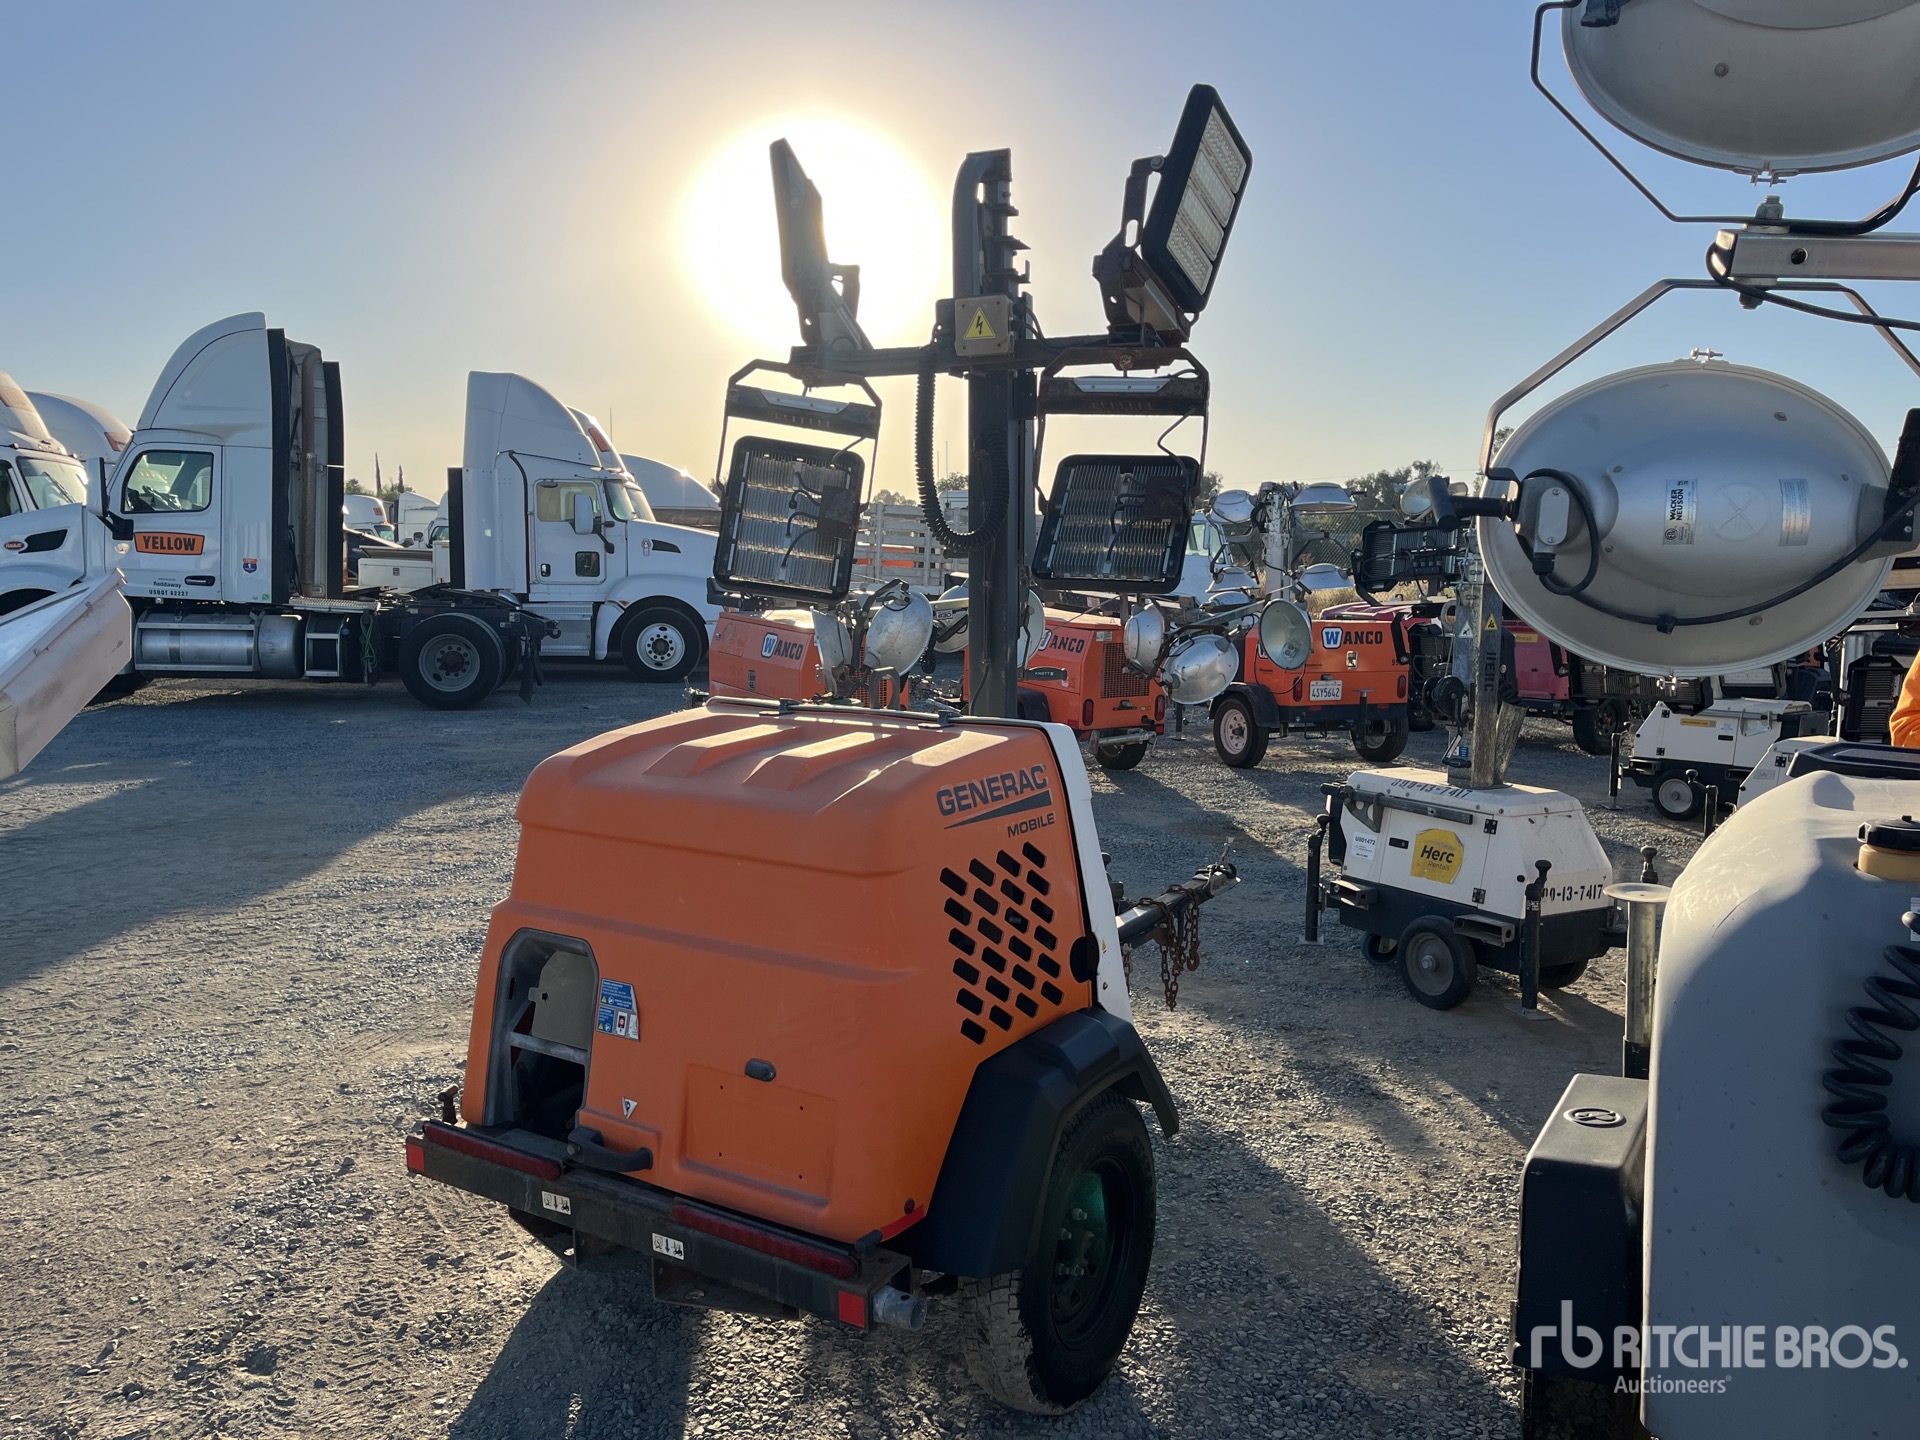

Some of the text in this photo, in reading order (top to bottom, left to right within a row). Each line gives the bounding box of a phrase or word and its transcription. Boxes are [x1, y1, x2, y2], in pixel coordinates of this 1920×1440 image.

[1670, 489, 1678, 521] WACKER
[1676, 489, 1684, 521] NEUSON
[142, 535, 196, 551] YELLOW
[763, 636, 804, 660] WANCO
[1324, 630, 1383, 645] WANCO
[1311, 687, 1340, 698] 4SY5642
[936, 765, 1048, 817] GENERAC
[1007, 812, 1055, 838] MOBILE
[1420, 845, 1455, 863] Herc
[1427, 861, 1451, 871] Rentals
